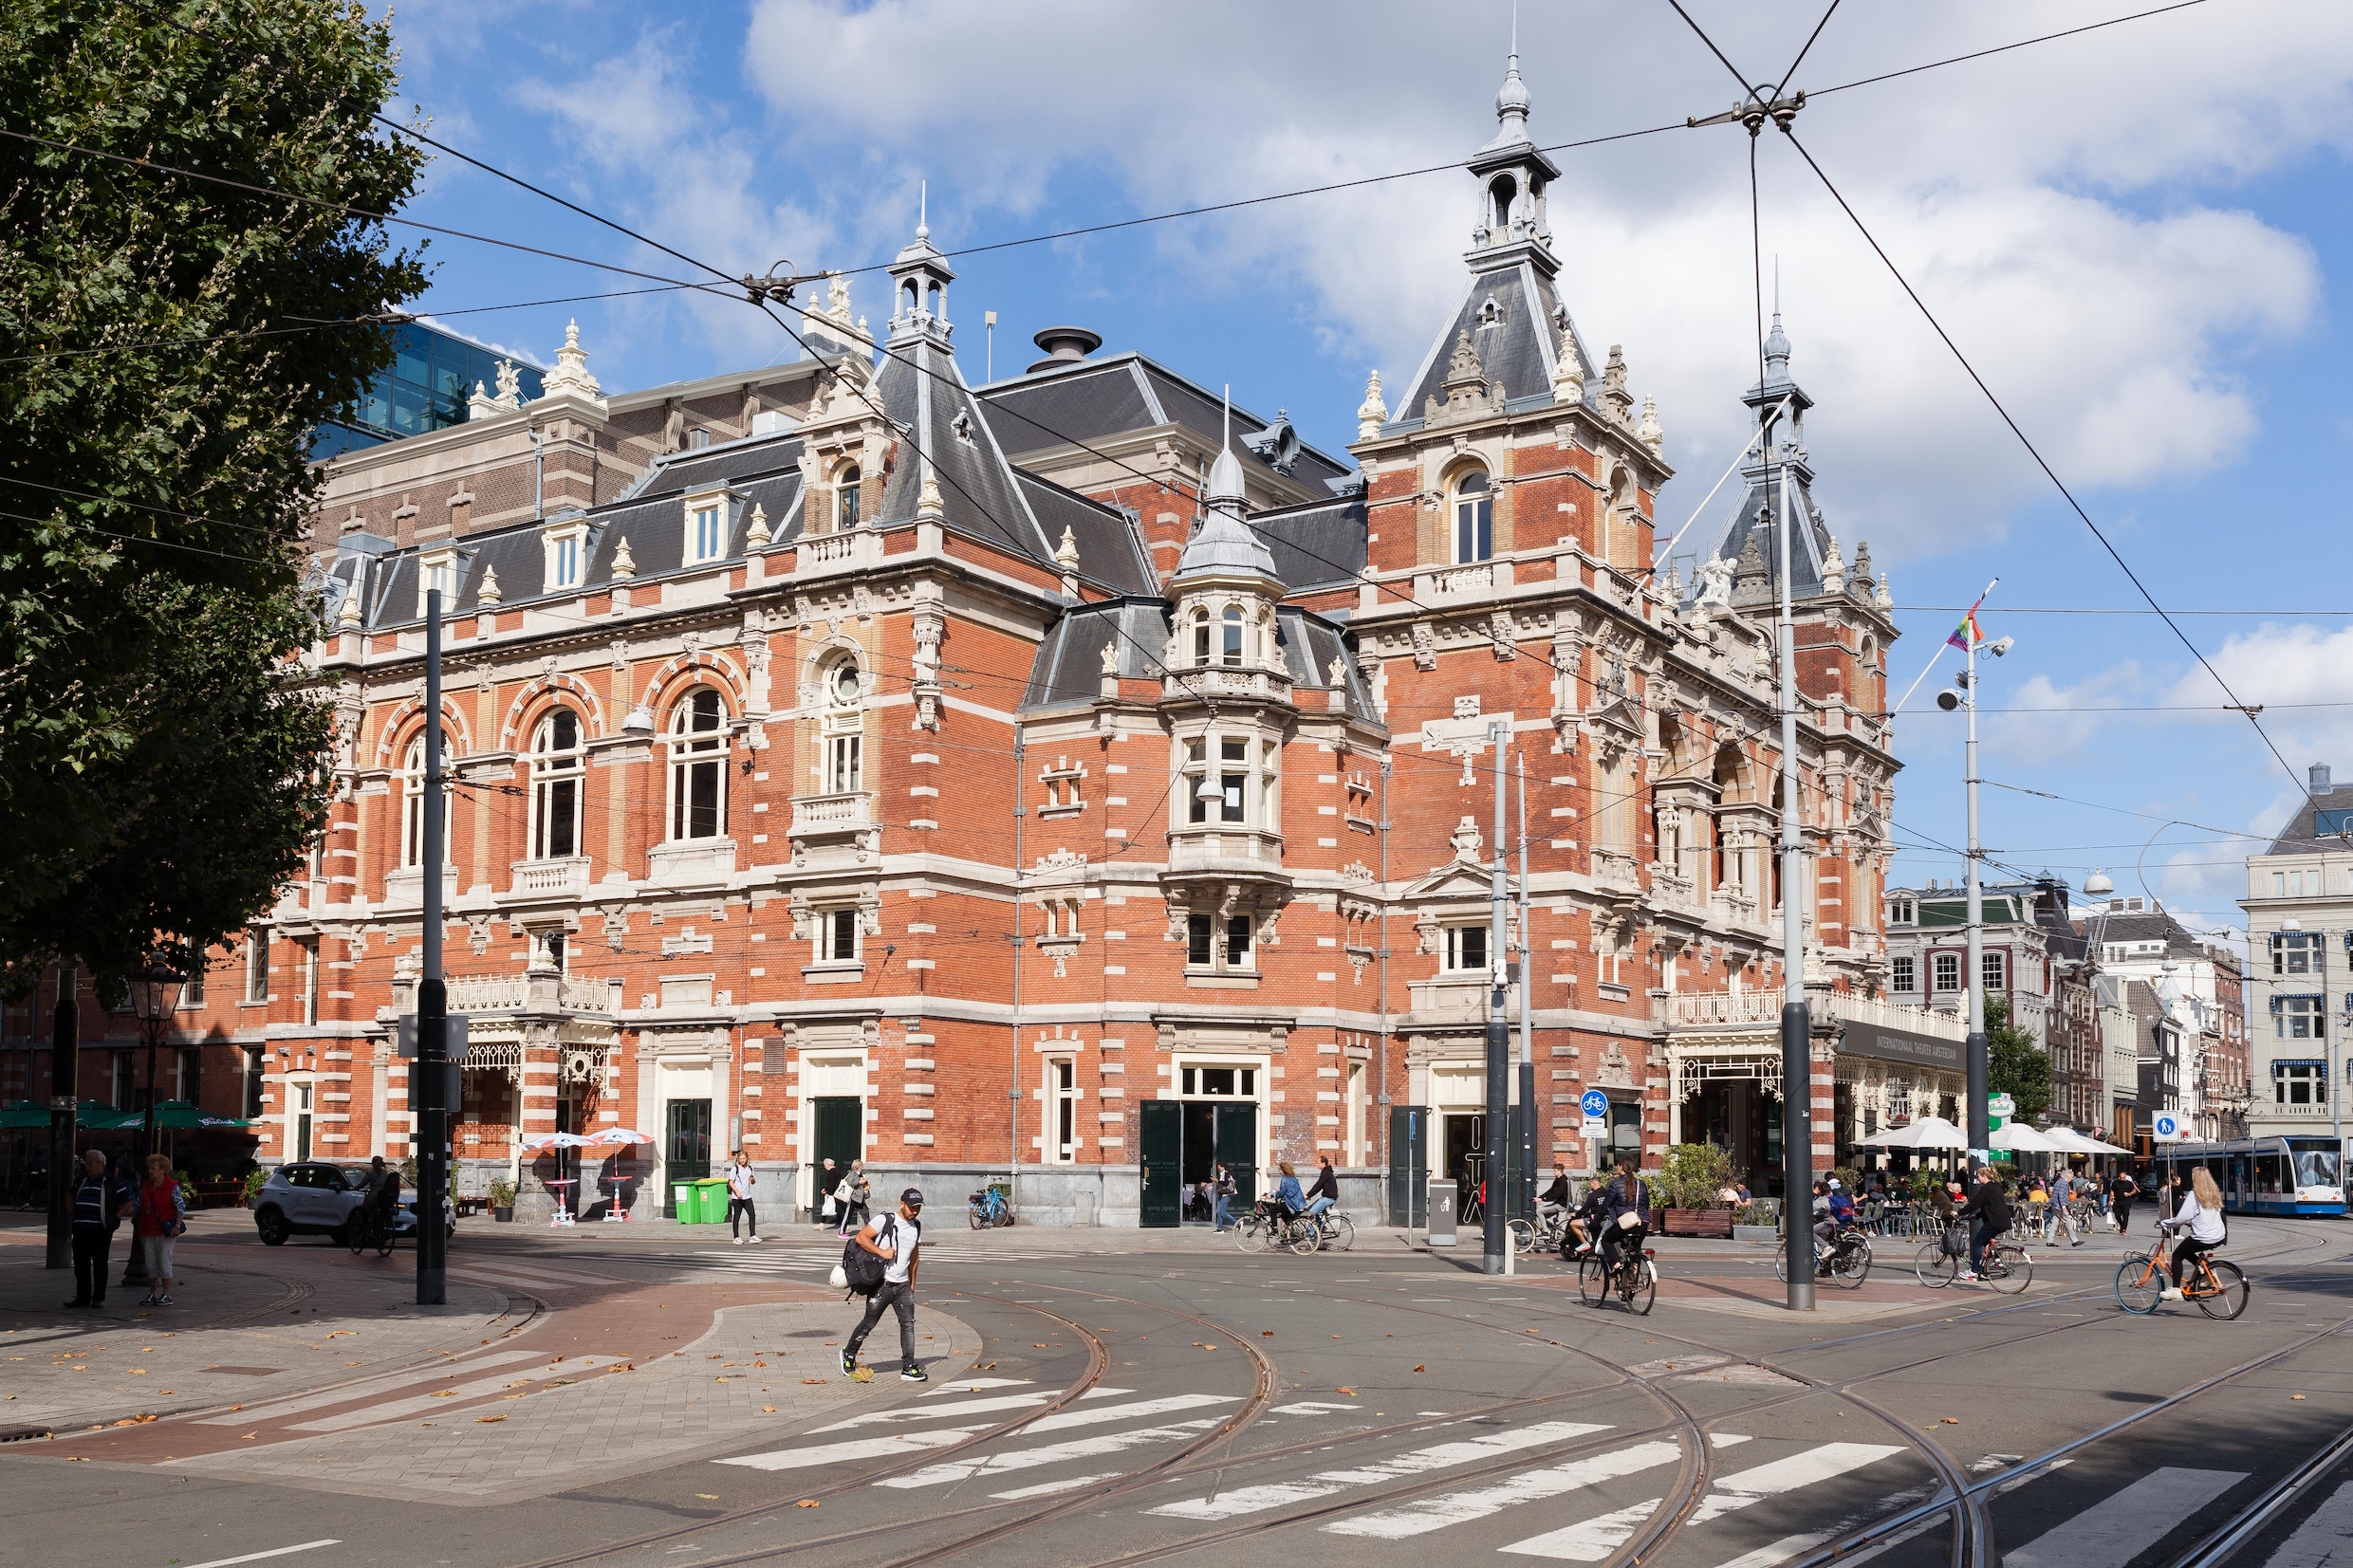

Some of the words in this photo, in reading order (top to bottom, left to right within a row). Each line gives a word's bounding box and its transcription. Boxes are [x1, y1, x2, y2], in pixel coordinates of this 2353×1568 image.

[1877, 1035, 1914, 1053] INTERNATIONAAL
[1914, 1042, 1932, 1056] THEATER
[1932, 1045, 1956, 1060] AMSTERDAM
[1989, 1103, 2010, 1112] Grolsch
